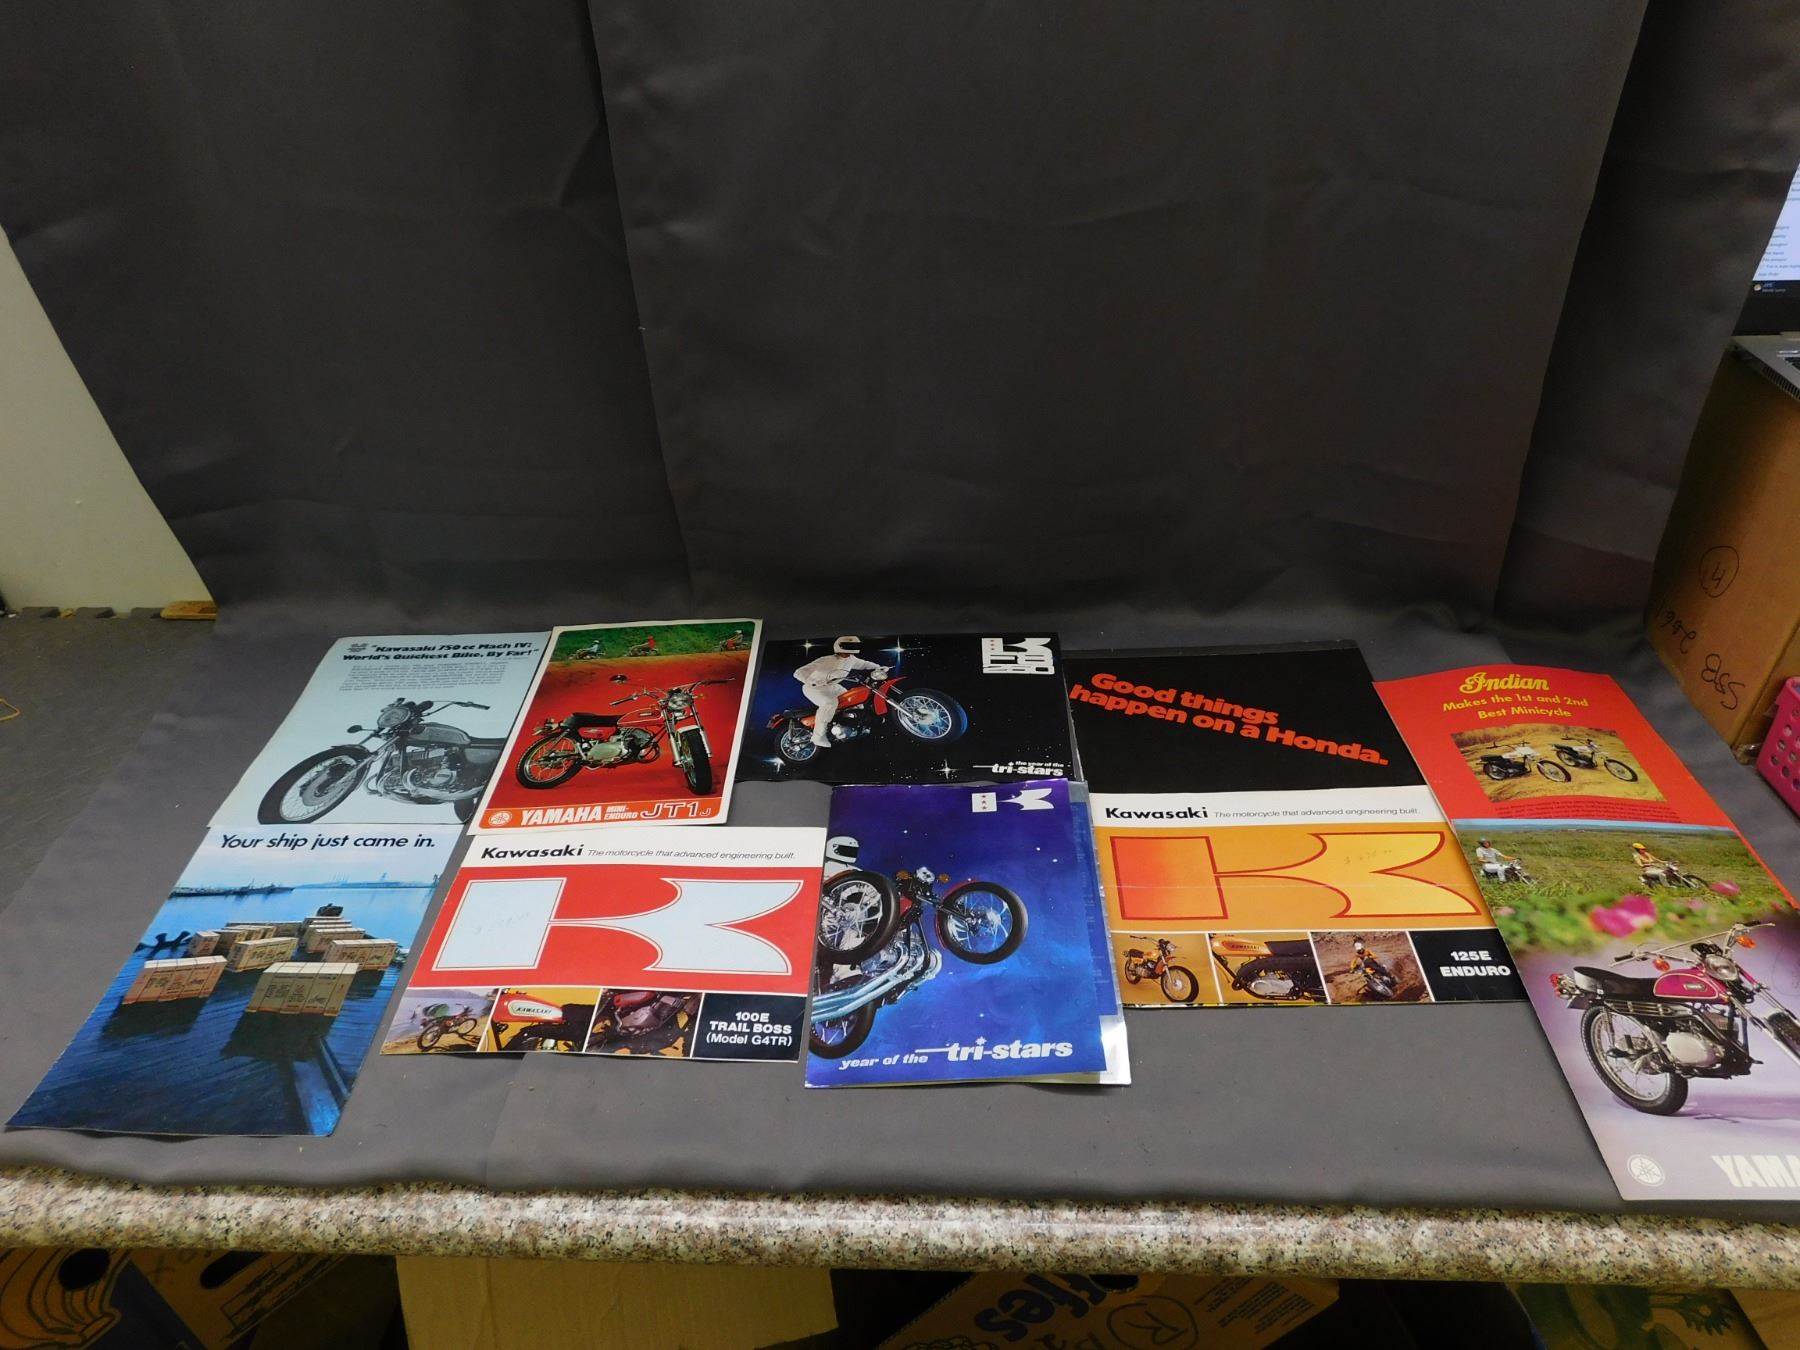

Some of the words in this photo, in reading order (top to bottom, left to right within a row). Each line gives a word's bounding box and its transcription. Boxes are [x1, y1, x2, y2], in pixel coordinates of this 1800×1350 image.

[478, 642, 511, 650] Mach
[343, 653, 392, 661] World's
[393, 652, 450, 661] Quickest
[486, 650, 503, 658] By
[1459, 672, 1550, 694] Indian
[1091, 673, 1177, 704] Good
[1180, 690, 1280, 725] things
[1443, 696, 1488, 711] Makes
[1491, 693, 1513, 704] the
[1516, 693, 1533, 703] 1st
[1536, 694, 1561, 704] and
[1565, 696, 1589, 707] 2nd
[1478, 707, 1508, 719] Best
[1511, 706, 1572, 718] Minicycle
[1069, 684, 1188, 724] happen
[1192, 715, 1236, 735] on
[1240, 724, 1261, 739] a
[1265, 727, 1389, 766] Honda.
[991, 761, 1064, 777] tri-stars
[520, 805, 603, 826] YAMAHA
[604, 811, 639, 820] ENDURO
[639, 801, 699, 820] JT1
[1105, 806, 1208, 820] Kawasaki
[1230, 811, 1280, 819] motorcycle
[1345, 808, 1398, 818] engineering
[220, 834, 263, 849] Your
[266, 833, 308, 849] ship
[311, 833, 349, 850] just
[353, 836, 409, 848] came
[414, 833, 435, 847] in.
[480, 844, 584, 859] Kawasaki
[605, 849, 653, 858] motorcycle
[655, 849, 672, 857] that
[673, 849, 718, 858] advanced
[719, 851, 772, 860] engineering
[1450, 950, 1491, 961] 125E
[1440, 964, 1511, 977] ENDURO
[735, 1011, 769, 1022] 100E
[709, 1021, 750, 1033] TRAIL
[752, 1023, 792, 1035] BOSS
[706, 1031, 749, 1045] (Model
[751, 1033, 792, 1047] G4TR)
[945, 1036, 1073, 1061] tri-stars
[838, 1057, 879, 1070] year
[882, 1055, 900, 1066] of
[902, 1053, 928, 1065] the
